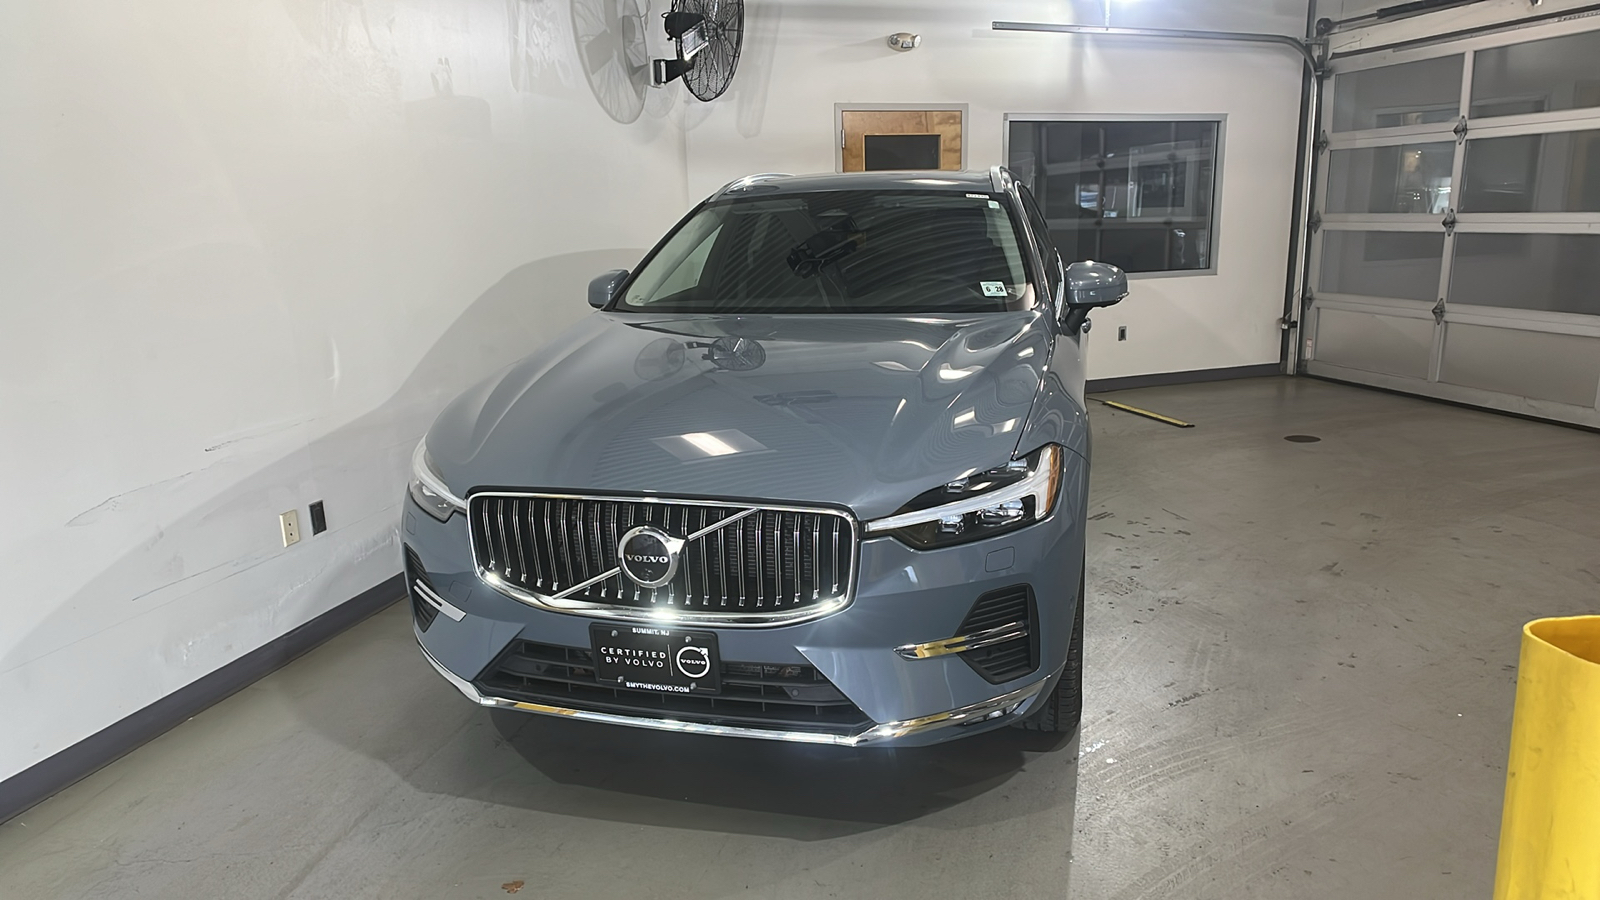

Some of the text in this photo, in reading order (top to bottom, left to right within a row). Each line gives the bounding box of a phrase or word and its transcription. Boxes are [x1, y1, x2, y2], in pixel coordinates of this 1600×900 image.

[625, 553, 669, 564] VOLVO
[600, 646, 666, 659] CERTIFIED
[605, 656, 664, 668] BY VOLVO
[625, 681, 690, 693] SMYTHEVOLVO.COM
